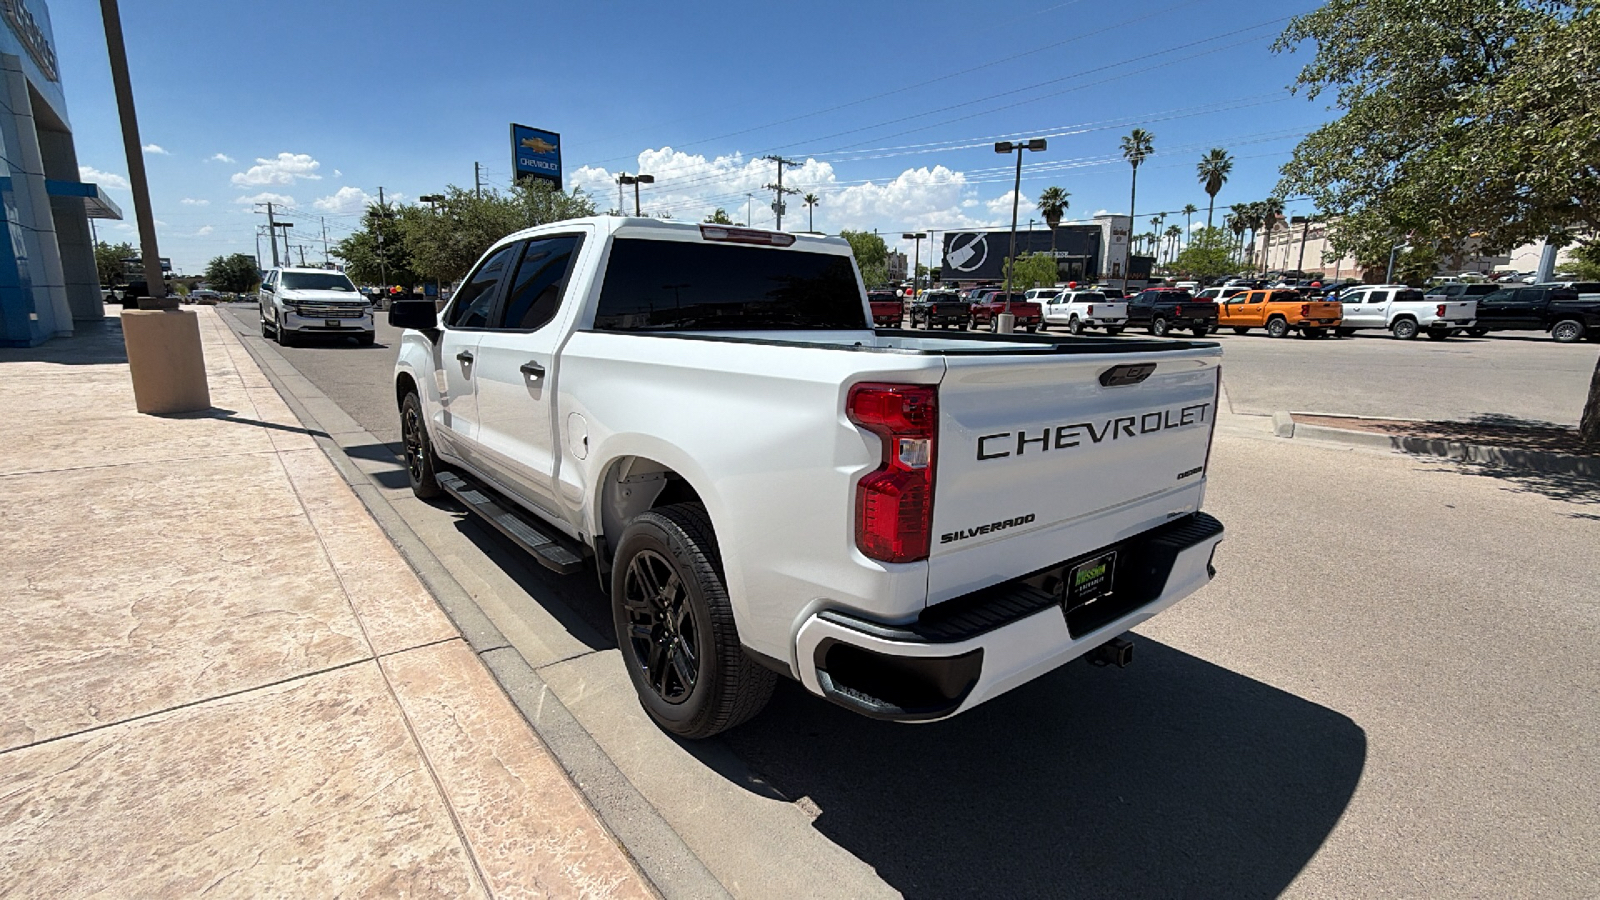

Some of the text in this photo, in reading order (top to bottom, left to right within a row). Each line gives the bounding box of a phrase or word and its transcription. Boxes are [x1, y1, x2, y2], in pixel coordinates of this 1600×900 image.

[520, 158, 558, 170] CHEVROLET
[976, 403, 1210, 461] CHEVROLET
[940, 513, 1035, 544] SILVERADO
